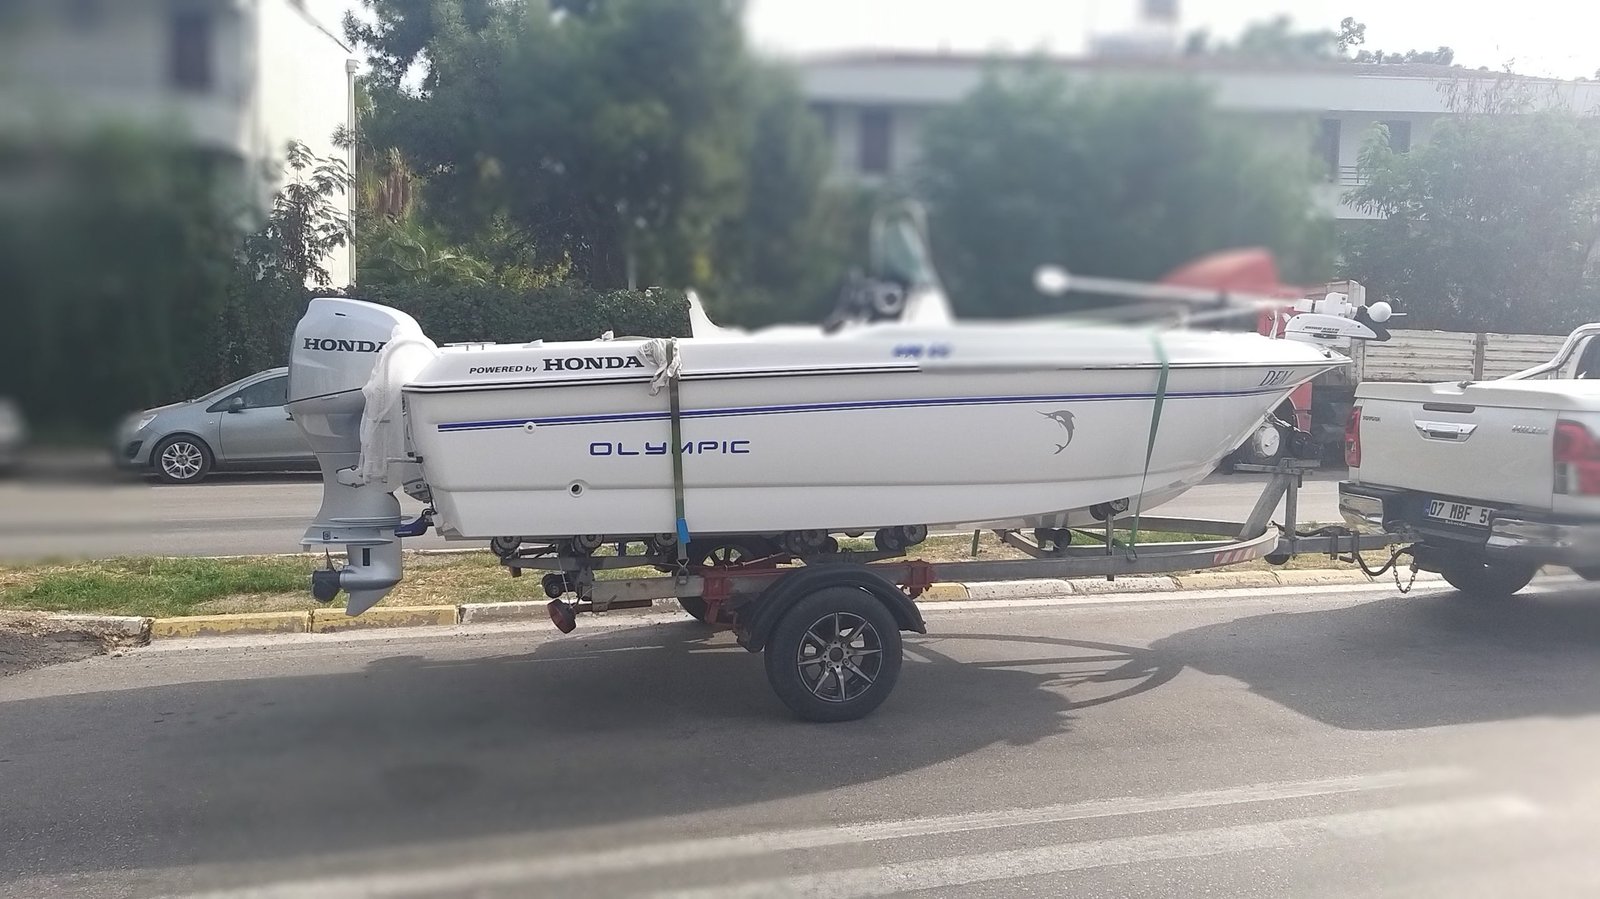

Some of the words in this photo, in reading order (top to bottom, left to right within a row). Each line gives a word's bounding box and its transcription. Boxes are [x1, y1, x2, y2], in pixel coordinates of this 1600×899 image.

[469, 365, 523, 374] POWERED
[525, 365, 538, 373] by
[542, 355, 645, 371] HONDA
[590, 440, 750, 456] OLYMPIC
[1430, 501, 1445, 516] 07
